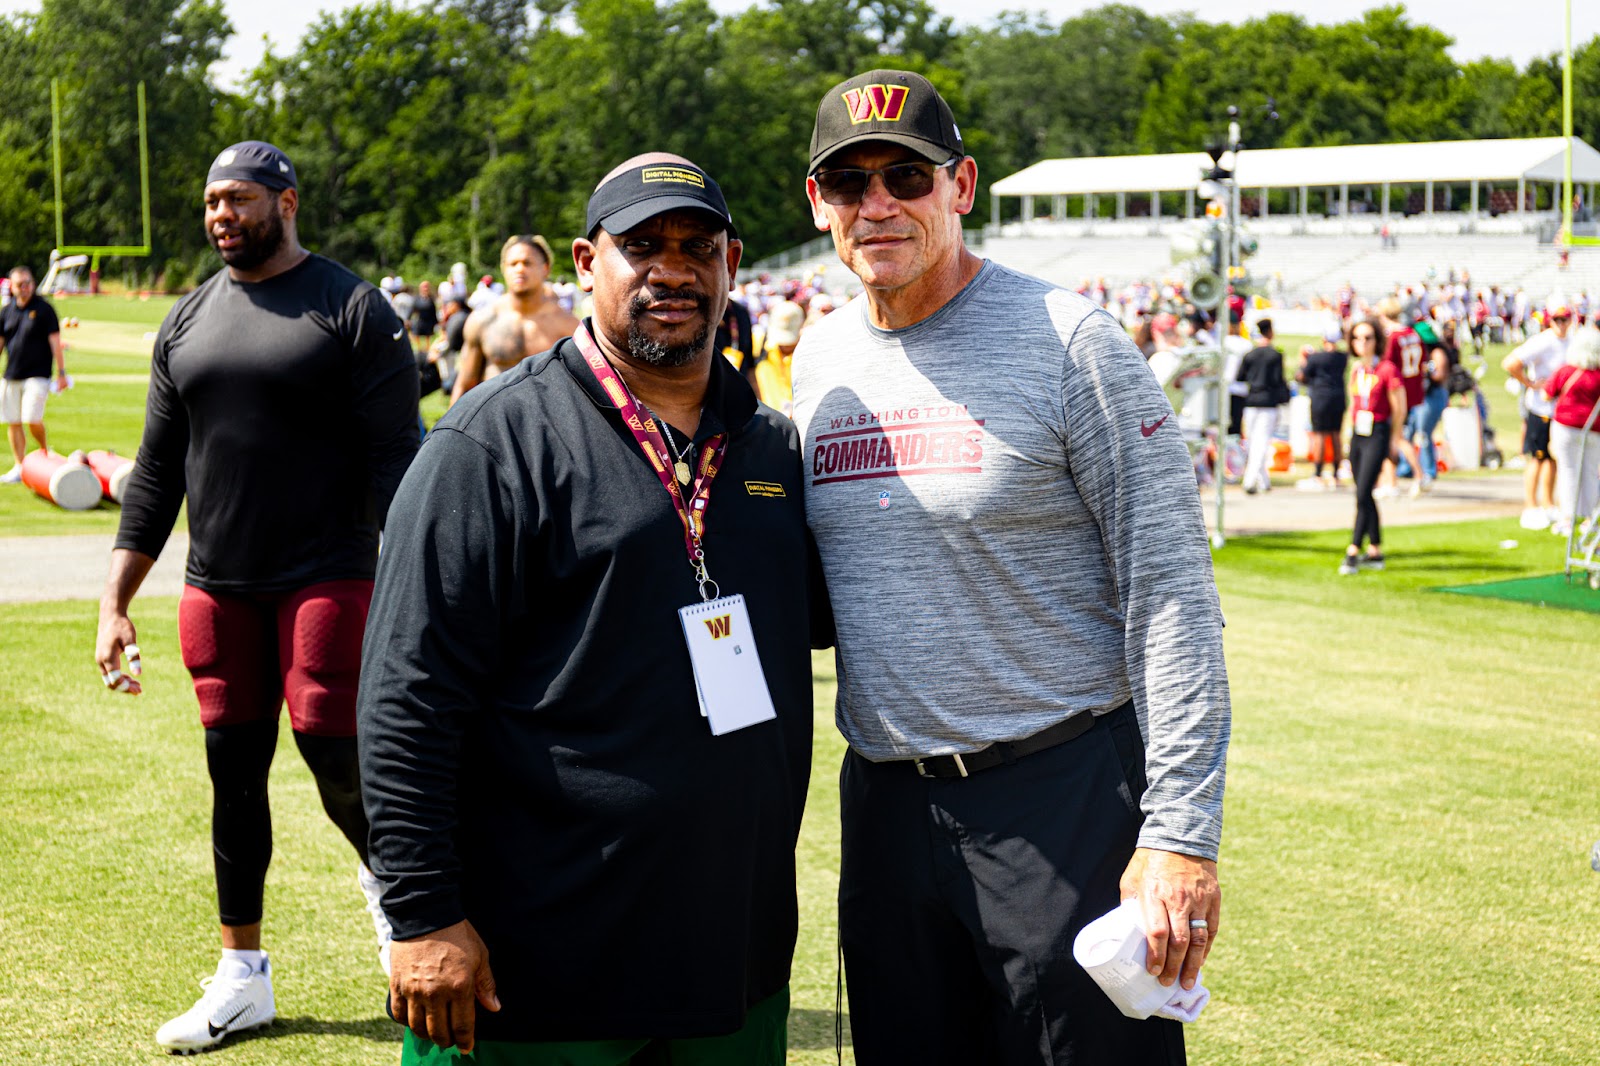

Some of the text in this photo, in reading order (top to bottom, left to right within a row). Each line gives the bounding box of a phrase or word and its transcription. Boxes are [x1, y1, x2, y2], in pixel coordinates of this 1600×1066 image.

[842, 84, 910, 125] W
[645, 171, 672, 179] DIGITAL
[830, 404, 968, 430] WASHINGTON
[813, 430, 984, 477] COMMANDERS
[704, 614, 731, 640] W
